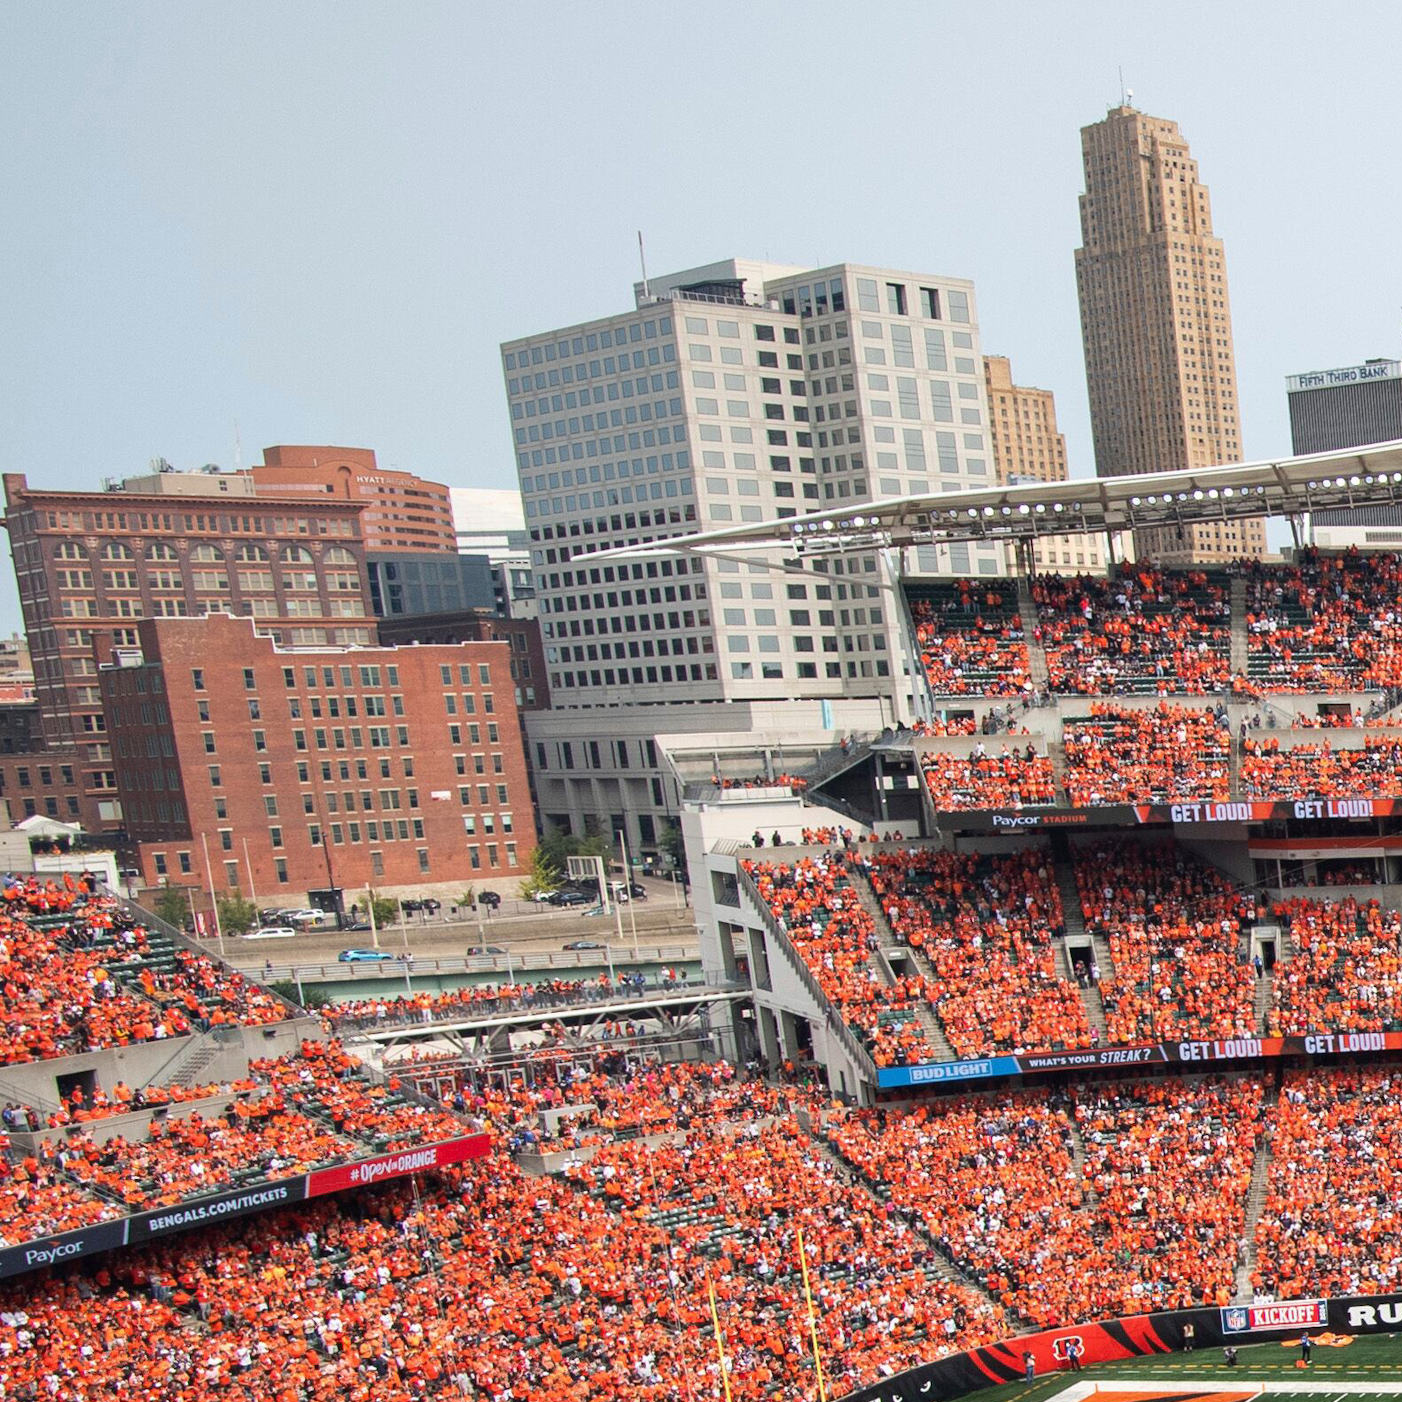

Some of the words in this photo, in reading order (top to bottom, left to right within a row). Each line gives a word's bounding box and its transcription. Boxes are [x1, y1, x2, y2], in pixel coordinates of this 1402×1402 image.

[1299, 376, 1324, 388] FIFTH
[1327, 371, 1356, 384] THIRD
[1360, 366, 1388, 380] BANK
[356, 475, 384, 484] HYATT
[1172, 803, 1202, 822] GET
[1206, 800, 1254, 820] LOUD!
[1295, 799, 1323, 818] GET
[1327, 797, 1373, 817] LOUD!
[992, 814, 1040, 827] Paycor
[1043, 814, 1087, 823] STADIUM
[1180, 1042, 1210, 1060] GET
[1214, 1038, 1262, 1058] LOUD!
[1305, 1034, 1334, 1053] GET
[1338, 1032, 1385, 1051] LOUD!
[1029, 1057, 1067, 1068] WHAT'S
[1068, 1054, 1096, 1065] YOUR
[1099, 1048, 1151, 1064] STREAK?
[912, 1066, 944, 1081] BUD
[945, 1062, 989, 1077] LIGHT
[149, 1187, 287, 1231] BENGALS.COM/TICKETS
[25, 1241, 84, 1265] Paycor
[1253, 1304, 1315, 1326] KICKOFF
